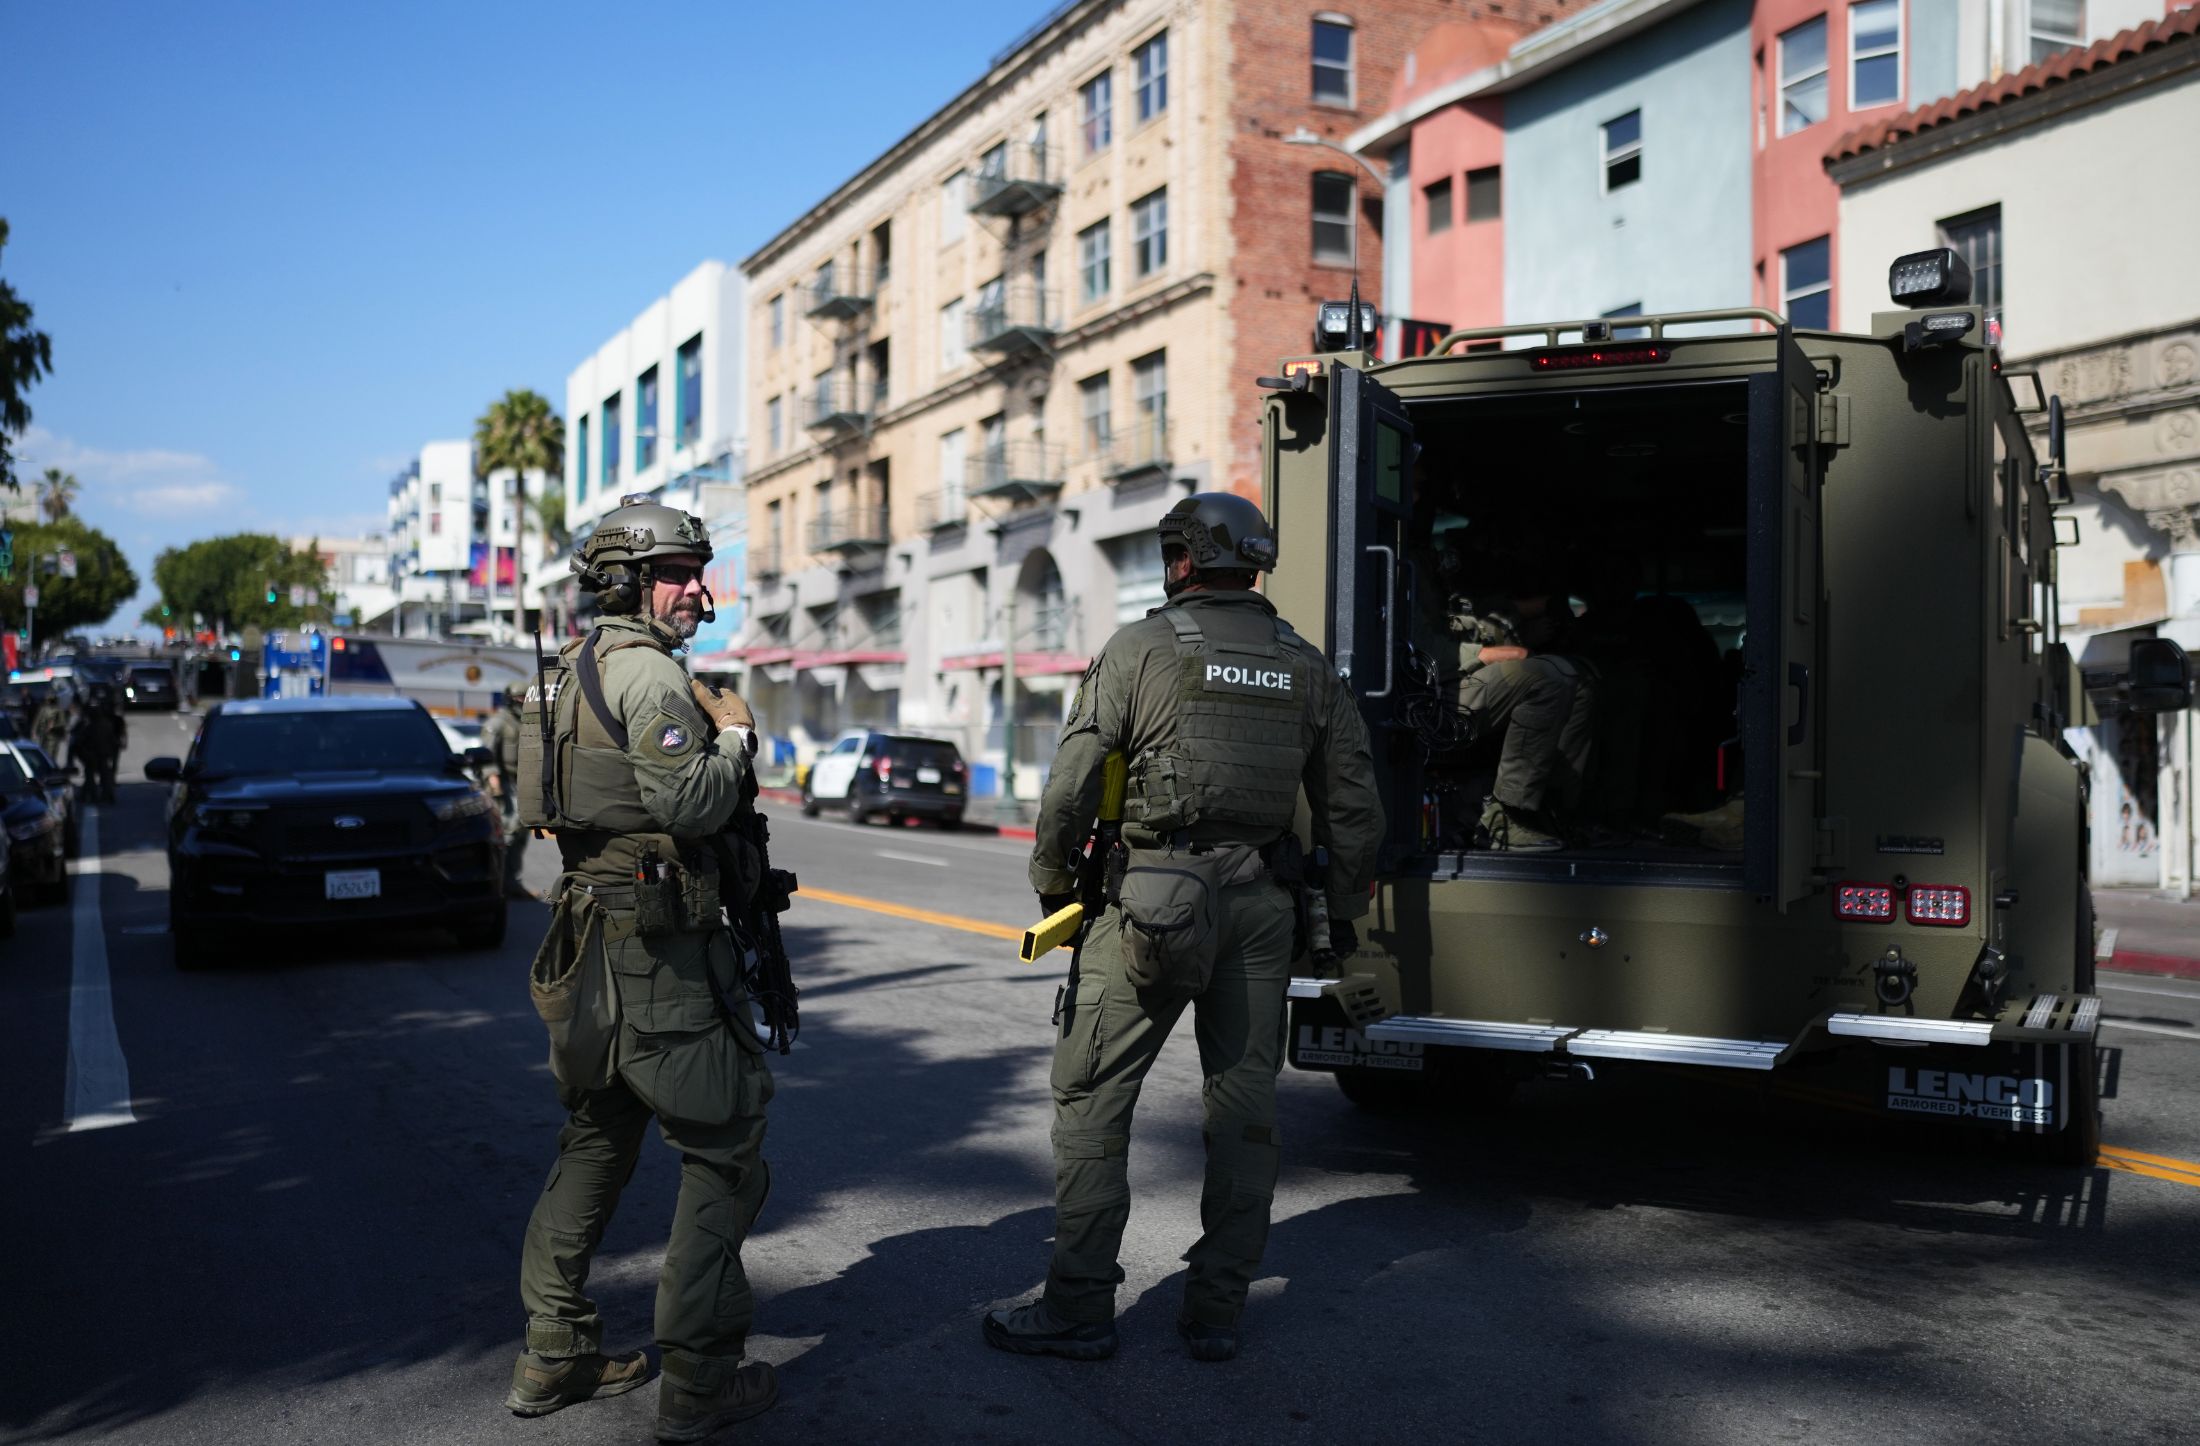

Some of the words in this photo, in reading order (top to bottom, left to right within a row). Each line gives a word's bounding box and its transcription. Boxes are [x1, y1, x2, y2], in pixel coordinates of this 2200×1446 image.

[1206, 664, 1291, 691] POLICE
[525, 683, 561, 703] POLCE
[1301, 1052, 1350, 1064] ARMORED
[1369, 1057, 1420, 1069] VEHICLES
[1888, 1067, 2053, 1107] LENCO
[1891, 1098, 1956, 1113] ARMORED
[1981, 1106, 2048, 1122] VEHICLES
